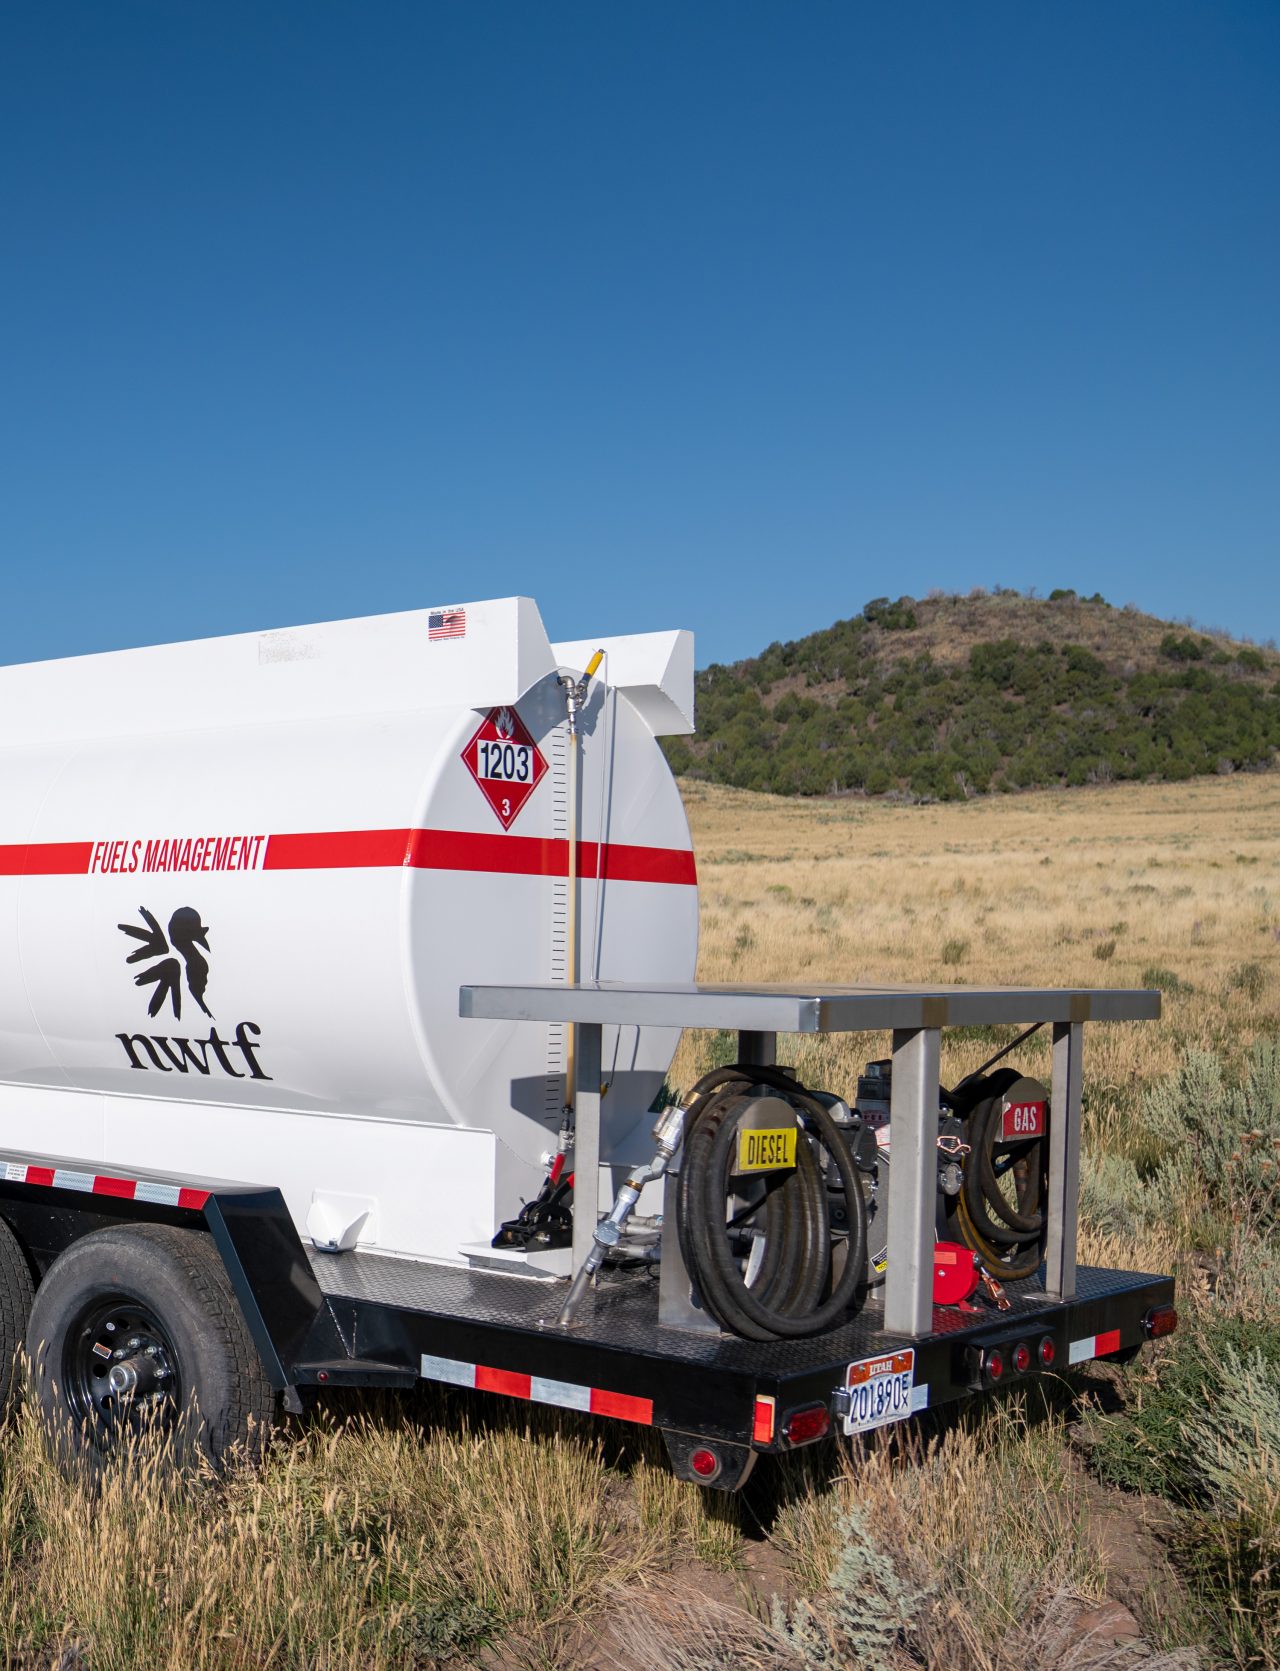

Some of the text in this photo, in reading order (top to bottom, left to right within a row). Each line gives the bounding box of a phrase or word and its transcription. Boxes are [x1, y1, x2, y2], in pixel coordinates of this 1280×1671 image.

[480, 742, 529, 781] 1203
[501, 798, 511, 816] 3
[91, 835, 265, 874] FUELS MANAGEMENT
[115, 1021, 273, 1080] nwtf
[1014, 1106, 1037, 1131] GAS
[747, 1134, 788, 1165] DIESEL
[868, 1360, 894, 1377] UTAH
[850, 1376, 901, 1424] 201890
